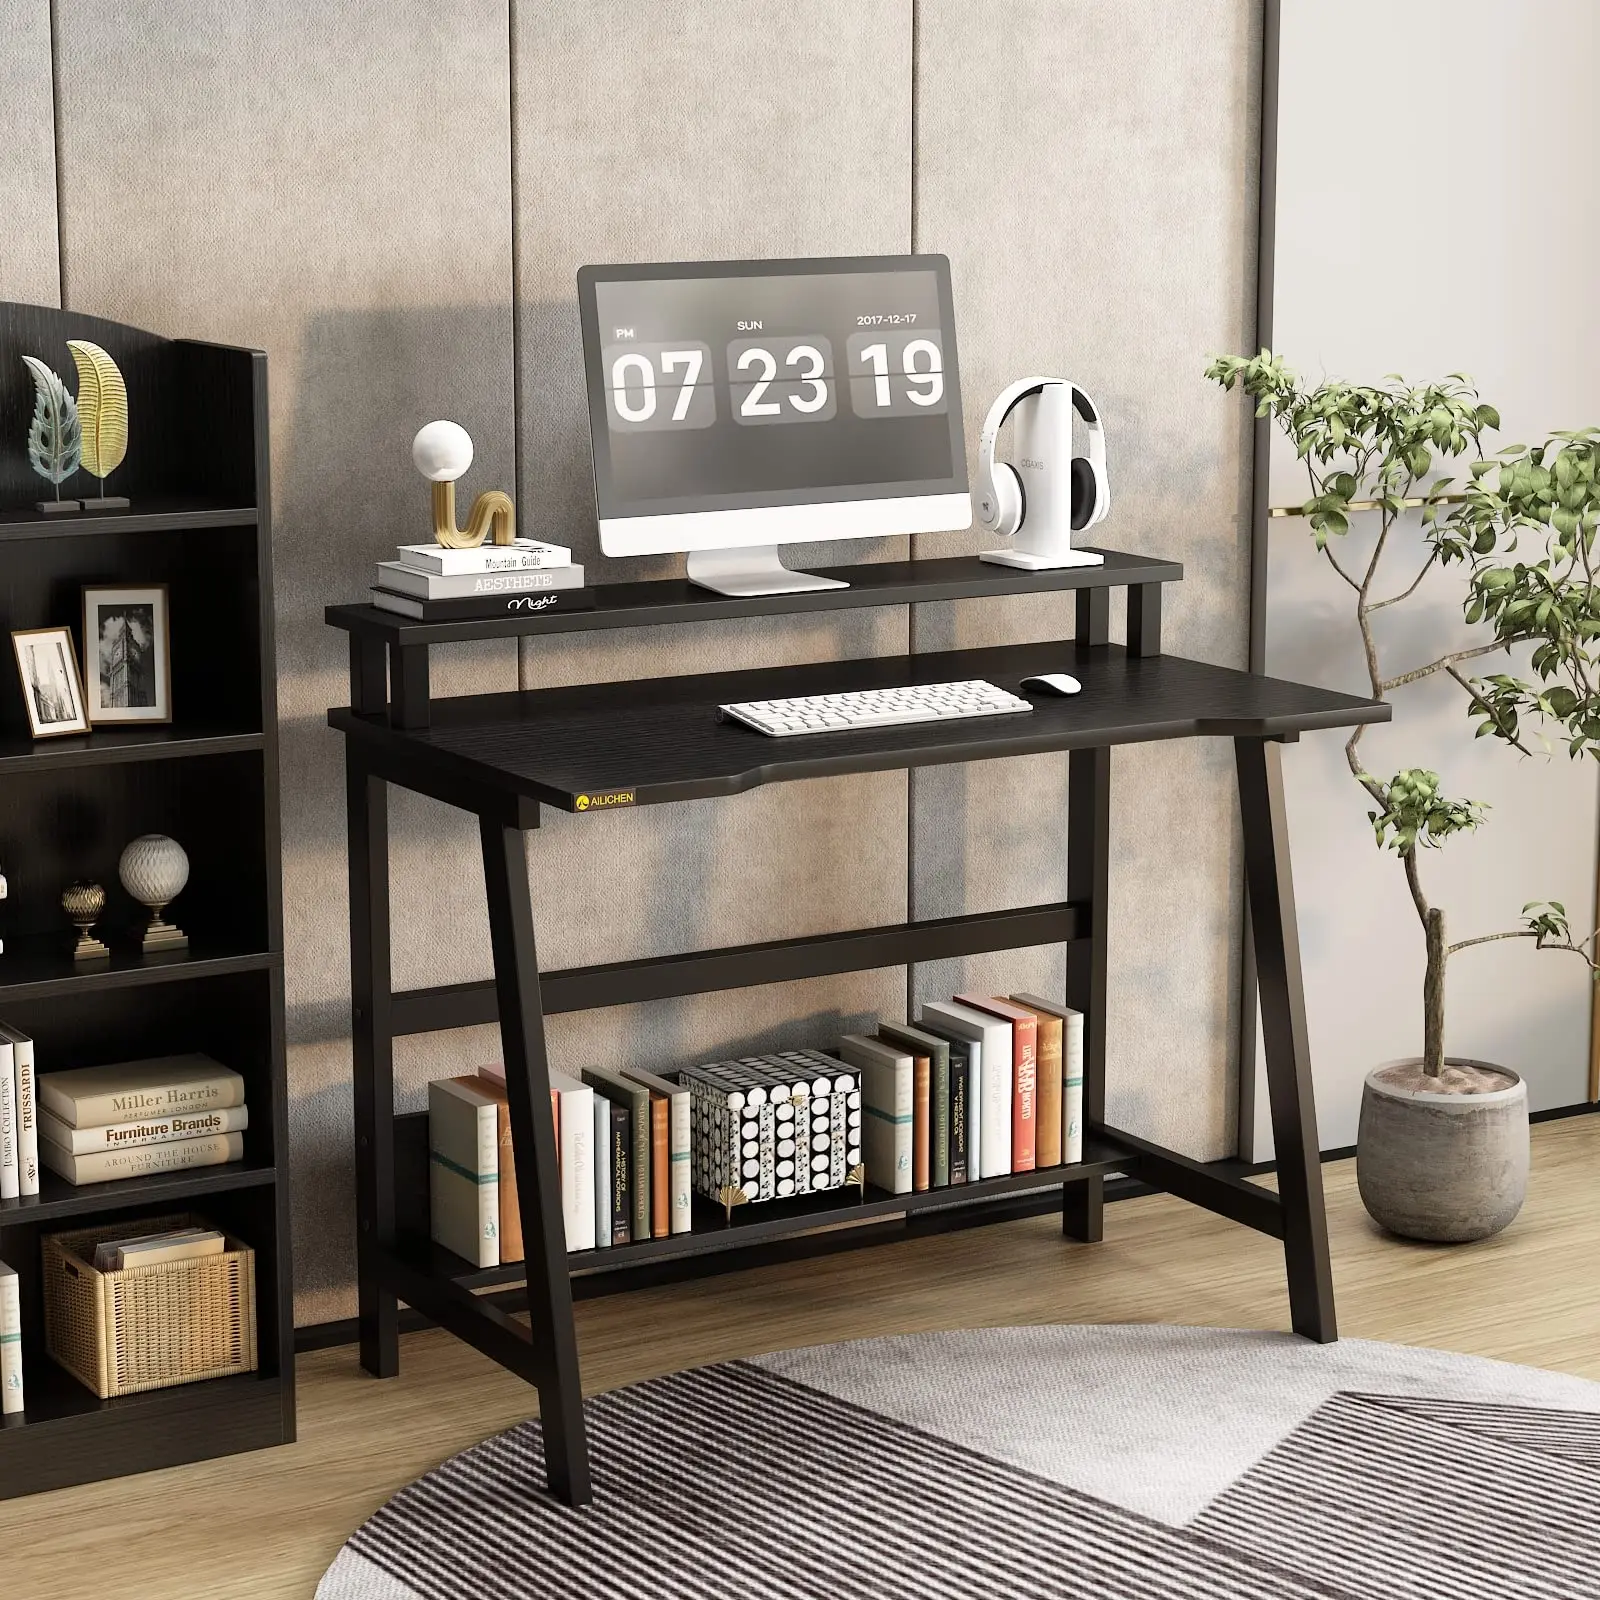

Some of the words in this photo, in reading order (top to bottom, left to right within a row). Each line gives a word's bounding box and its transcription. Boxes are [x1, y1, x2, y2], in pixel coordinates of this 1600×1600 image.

[736, 320, 763, 331] SUN
[857, 313, 917, 326] 2017-12-17
[616, 328, 635, 339] PM
[736, 344, 829, 417] 23
[859, 338, 945, 408] 19
[611, 349, 704, 423] 07
[485, 557, 517, 570] Mountain
[521, 555, 541, 567] Guide
[473, 574, 553, 592] AESTHETE
[507, 595, 558, 610] Night
[590, 792, 634, 806] AILICHEN
[21, 1063, 33, 1132] TRUSSARDI
[112, 1096, 163, 1113] Miller
[166, 1085, 219, 1104] Harris
[170, 1102, 208, 1113] LONDON
[106, 1122, 169, 1143] Furniture
[172, 1114, 221, 1132] Brands
[106, 1127, 221, 1147] INTERNATIONAL
[2, 1137, 13, 1167] JUMBO
[104, 1154, 152, 1168] AROUND
[157, 1149, 179, 1159] THE
[183, 1143, 220, 1156] HOUSE
[130, 1155, 195, 1173] FURNITURE
